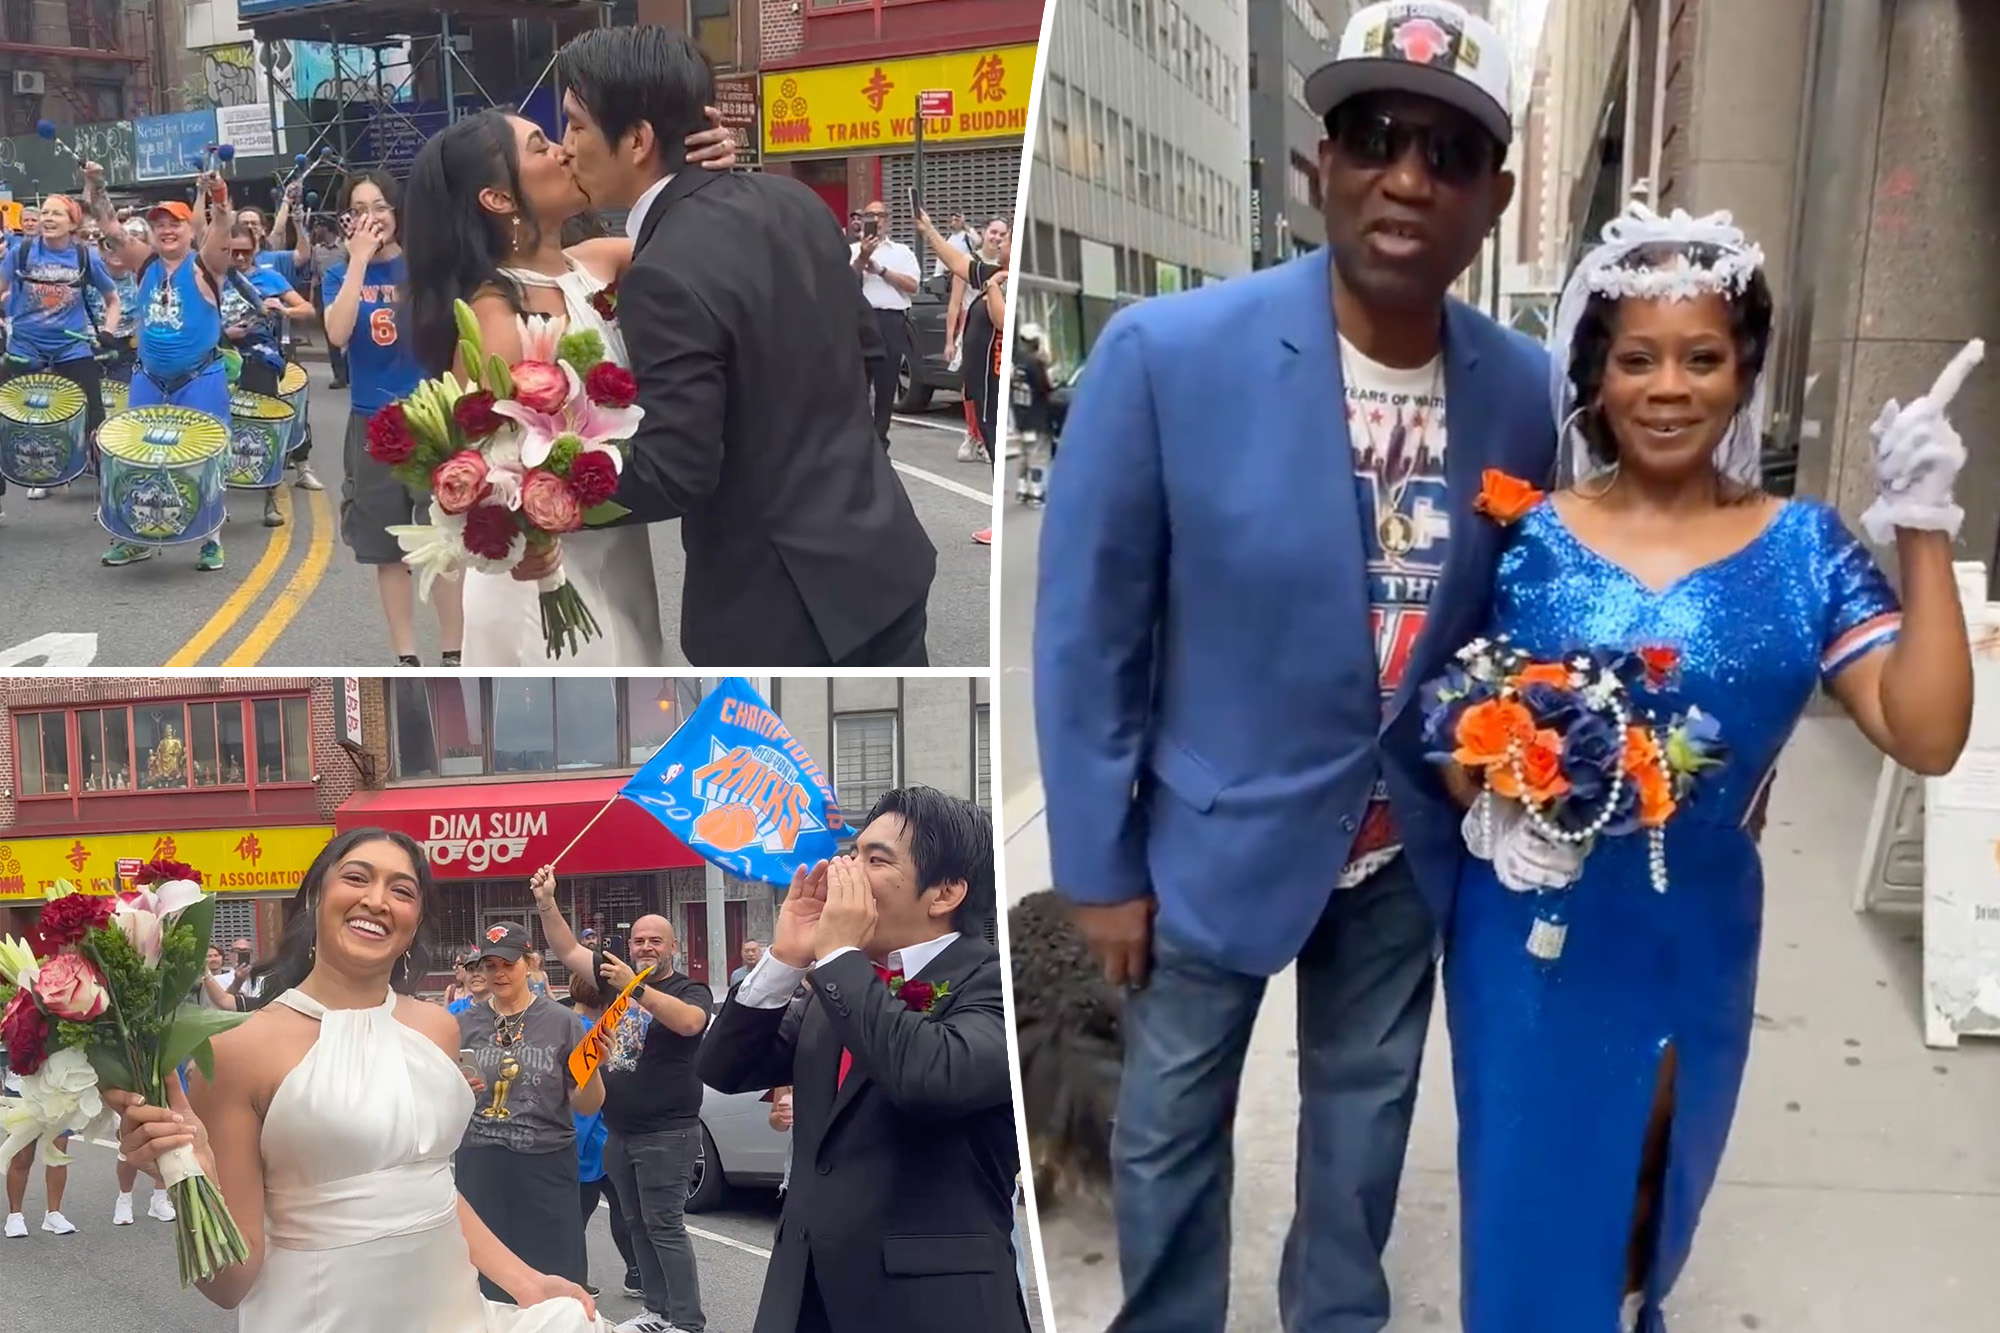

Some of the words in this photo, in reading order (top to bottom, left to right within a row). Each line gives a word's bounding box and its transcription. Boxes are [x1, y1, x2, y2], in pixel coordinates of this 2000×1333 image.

[826, 120, 881, 143] TRANS
[370, 308, 397, 346] 6
[695, 747, 809, 850] KNICKS
[429, 814, 481, 840] DIM
[489, 811, 548, 838] SUM
[521, 1072, 542, 1087] 26
